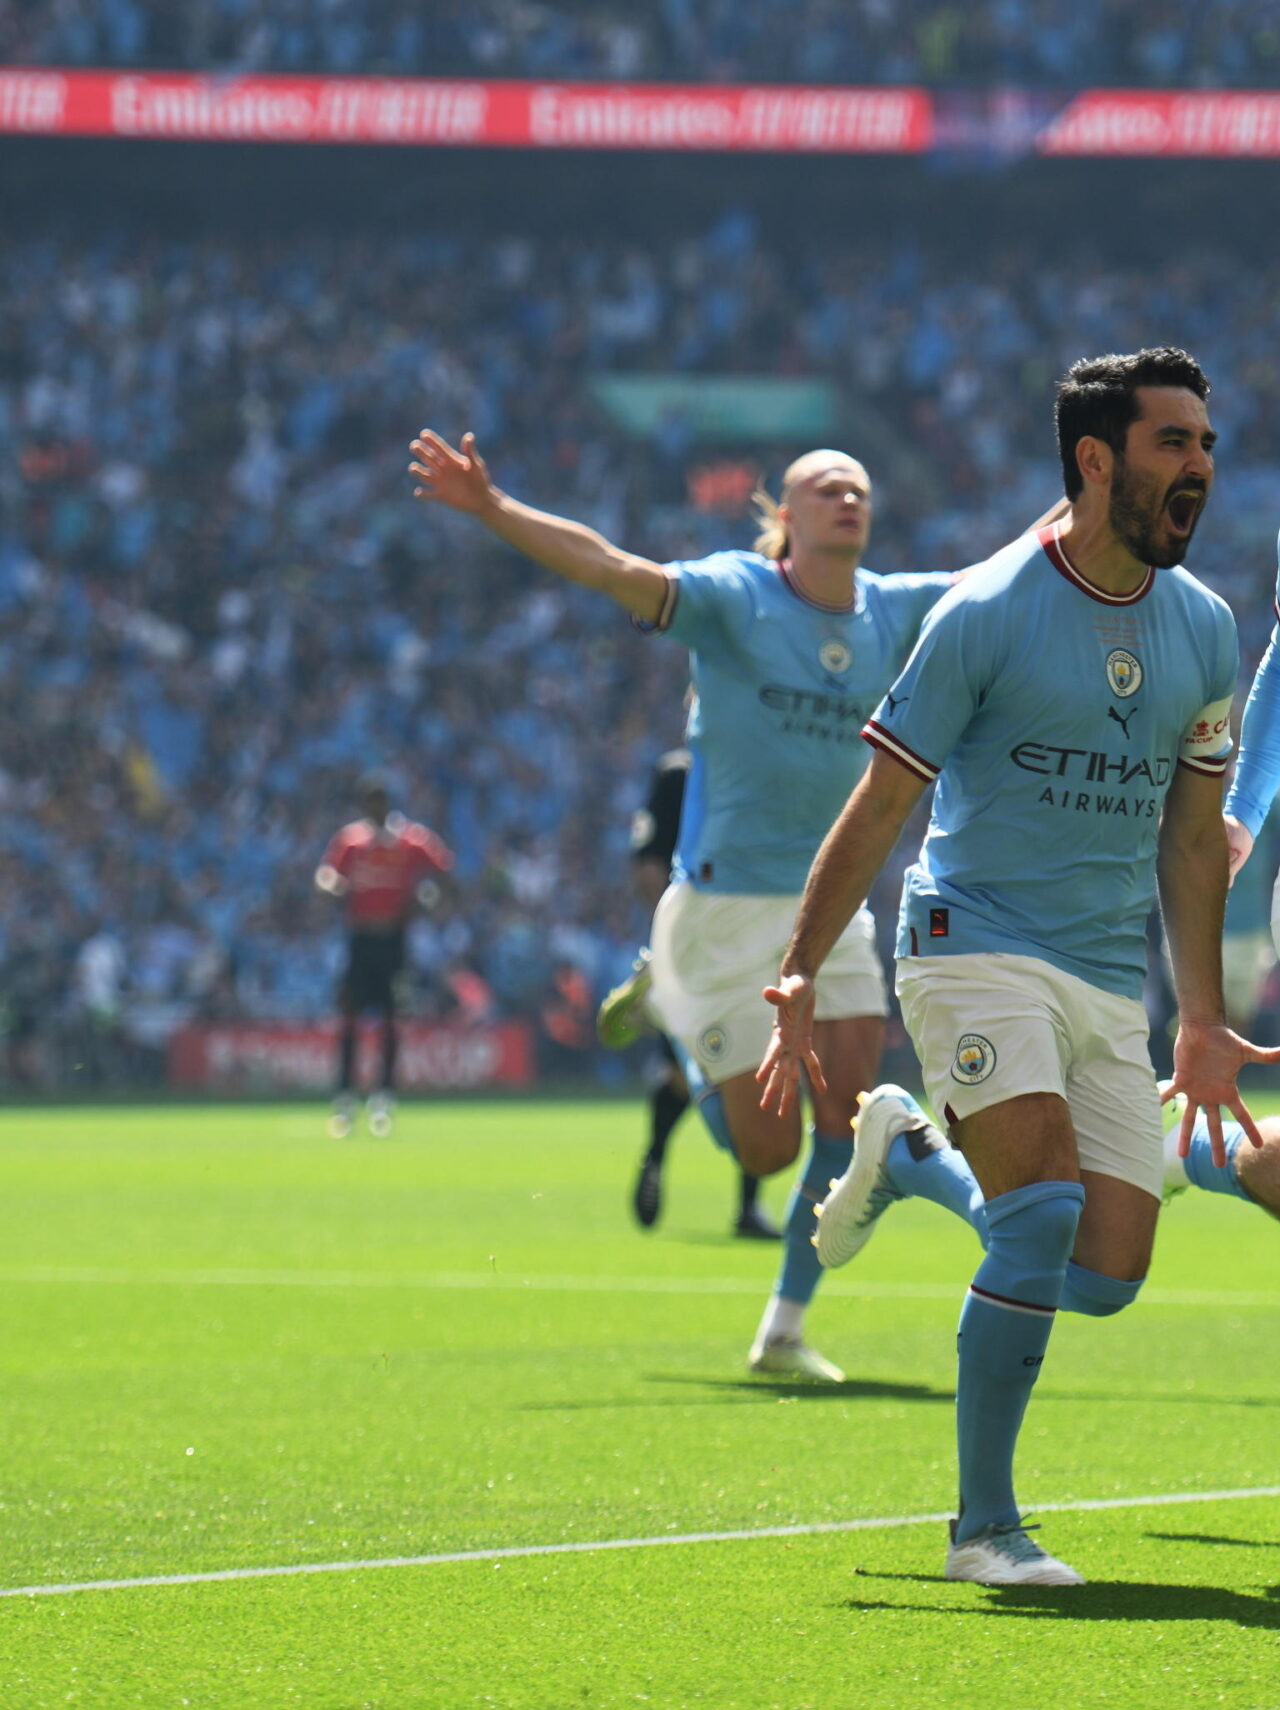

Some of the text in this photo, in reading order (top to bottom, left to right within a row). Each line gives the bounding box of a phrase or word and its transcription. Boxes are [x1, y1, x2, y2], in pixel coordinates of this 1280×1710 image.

[759, 684, 873, 722] ETIHA
[1010, 742, 1170, 787] ETIHAD
[1038, 786, 1156, 817] AIRWAYS
